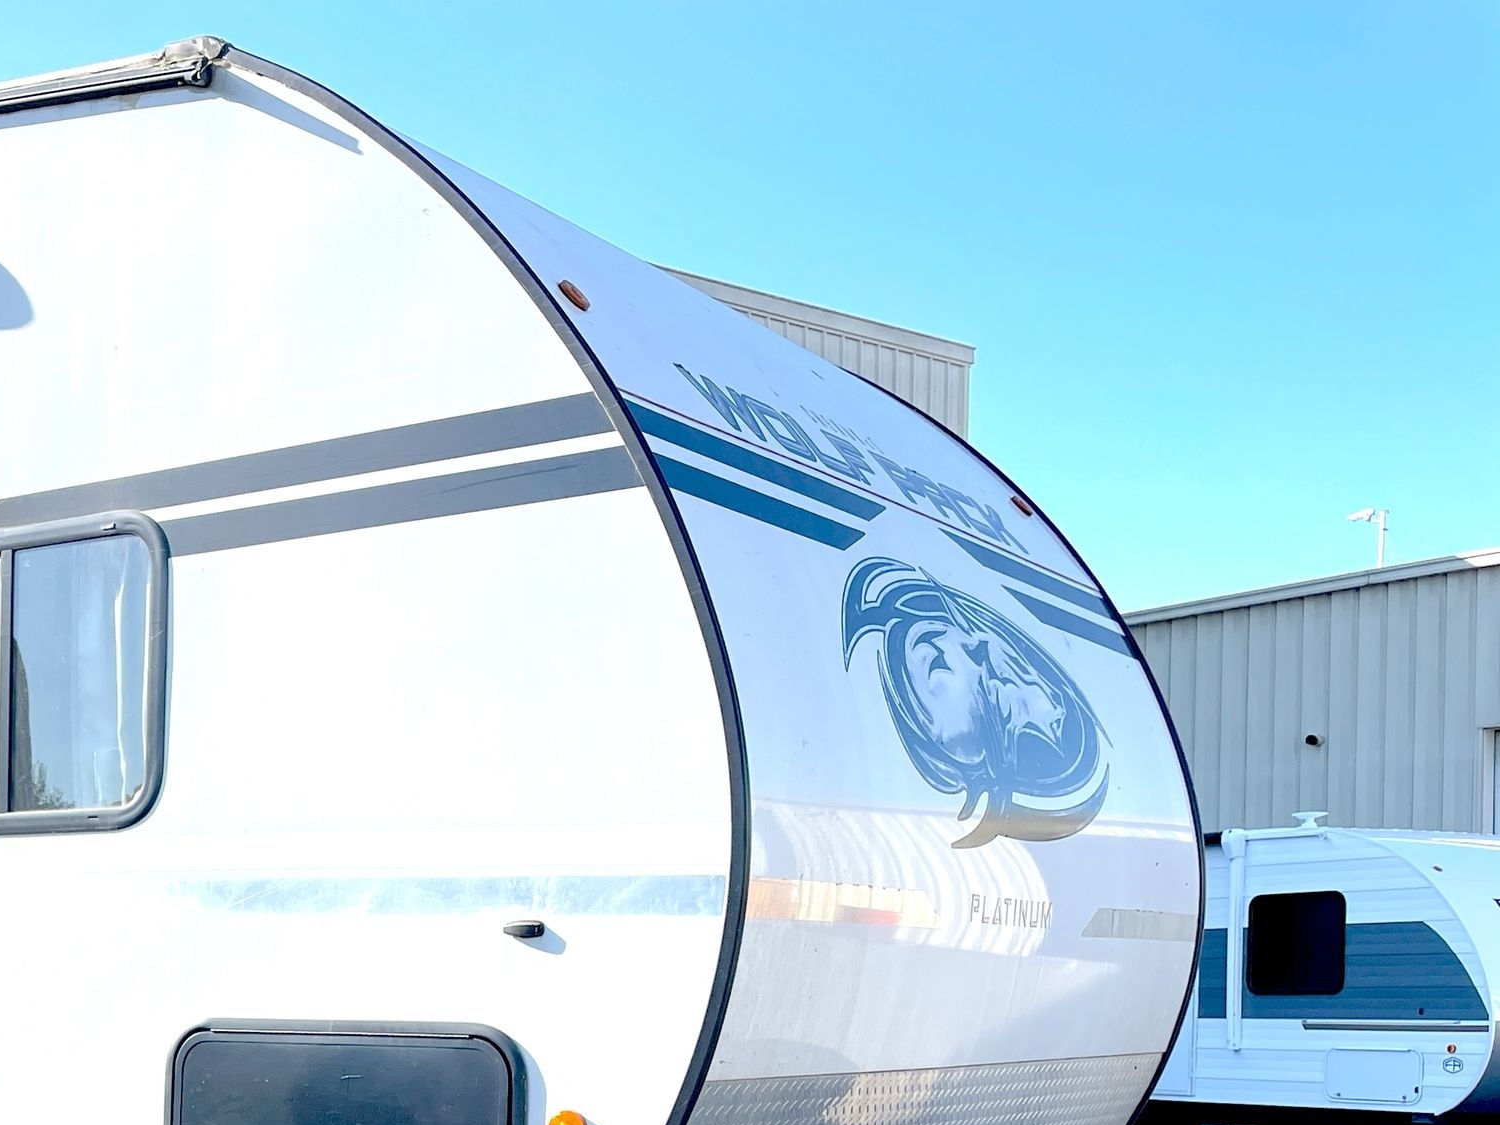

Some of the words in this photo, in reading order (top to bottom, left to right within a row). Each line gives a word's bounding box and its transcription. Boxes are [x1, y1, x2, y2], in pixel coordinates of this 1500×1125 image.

[672, 361, 876, 487] WOLF
[867, 449, 1030, 556] PACK
[970, 893, 1053, 929] PLATINUM
